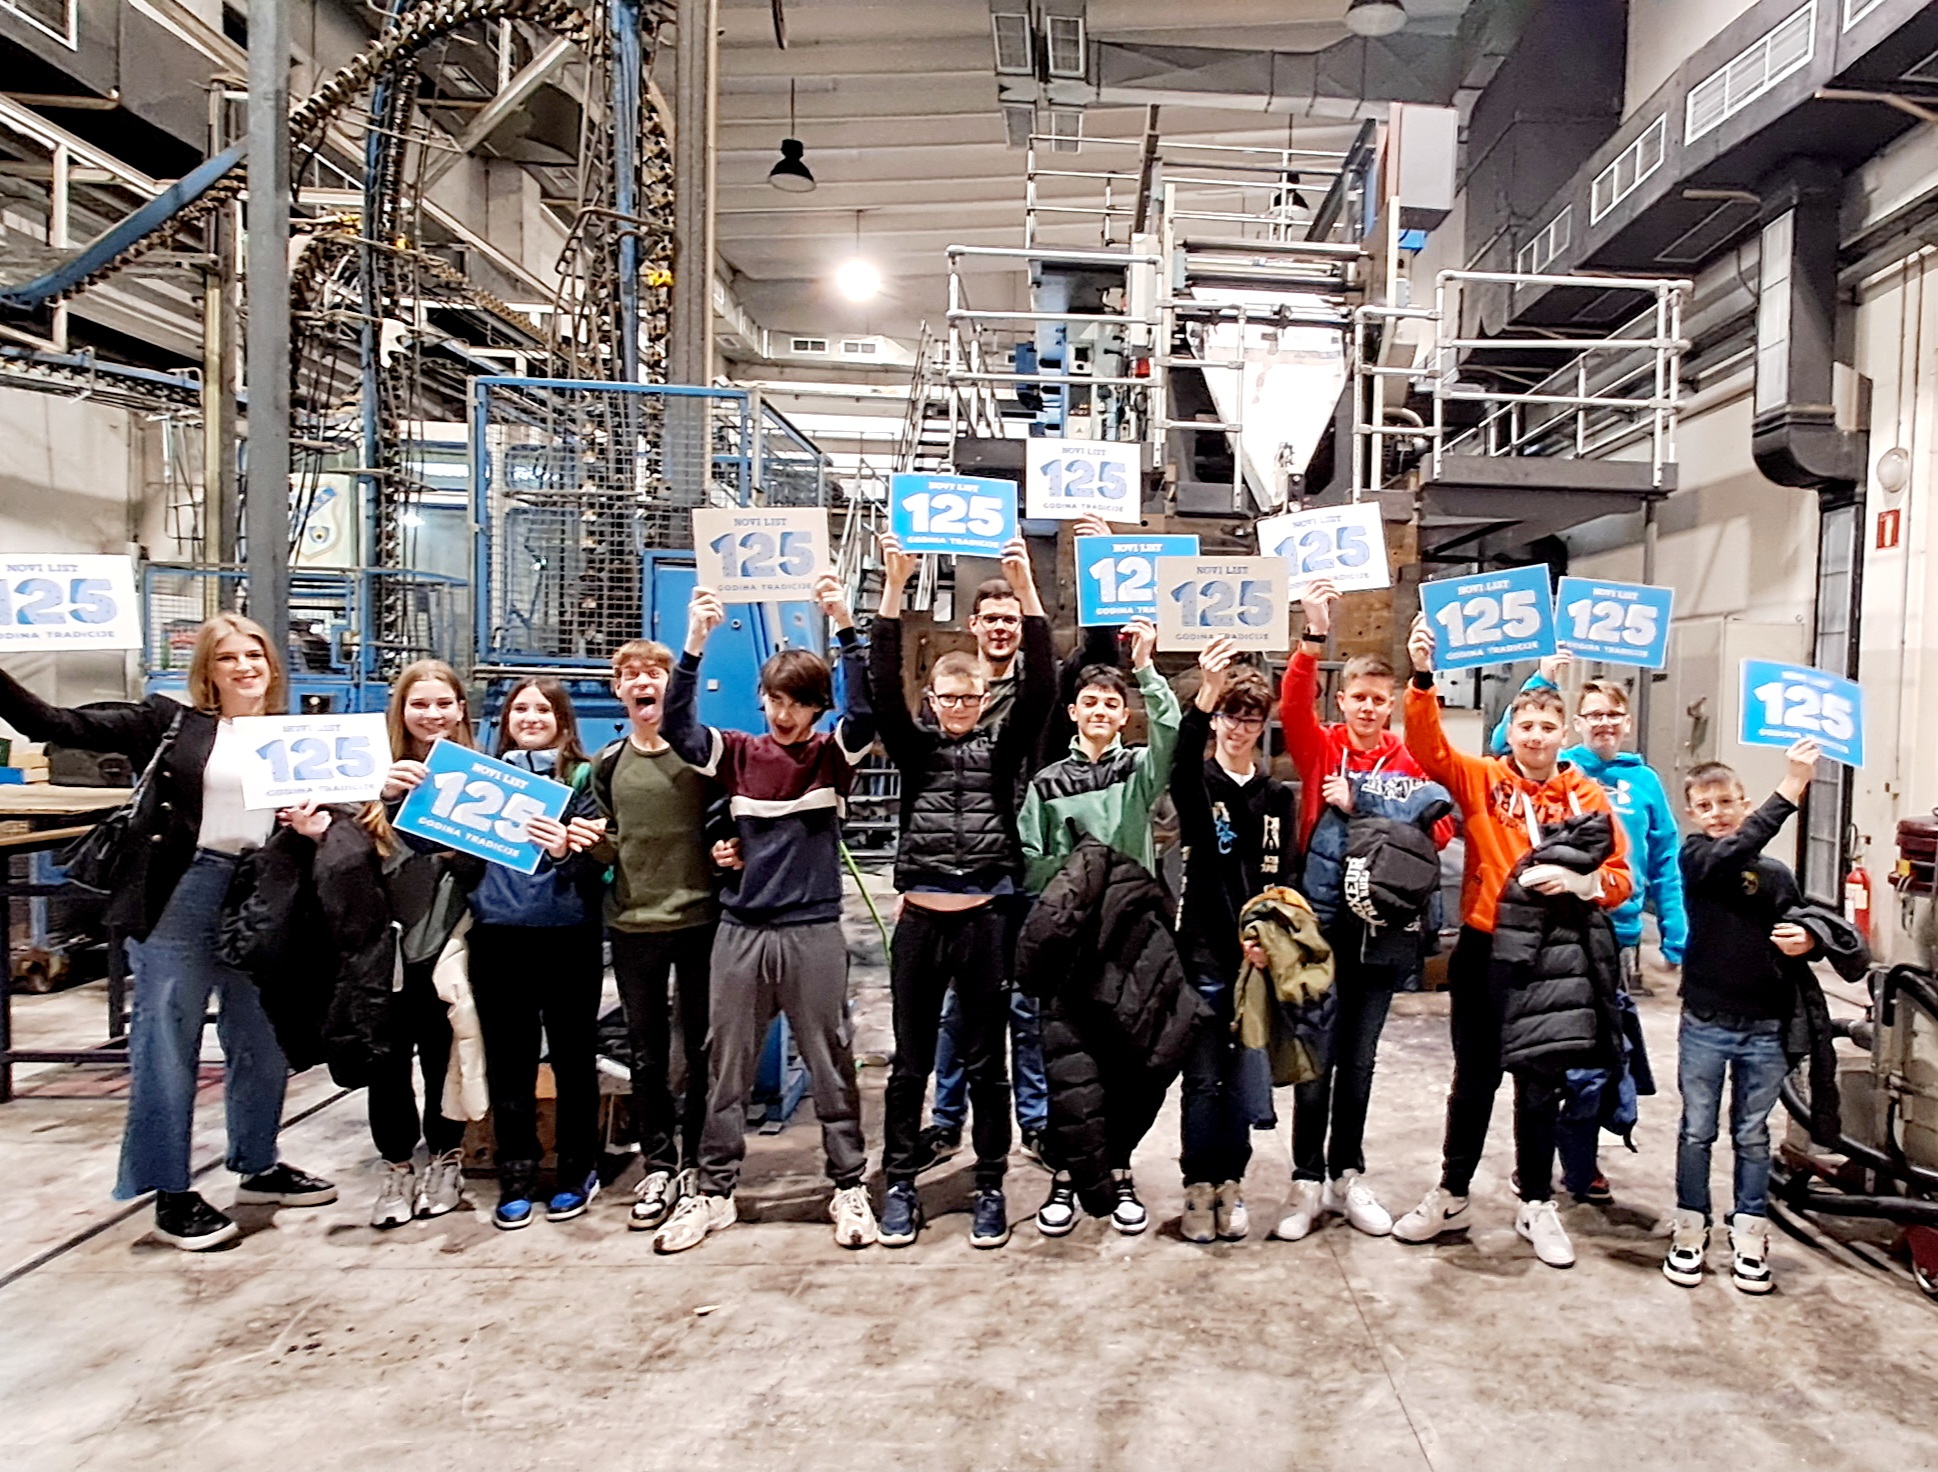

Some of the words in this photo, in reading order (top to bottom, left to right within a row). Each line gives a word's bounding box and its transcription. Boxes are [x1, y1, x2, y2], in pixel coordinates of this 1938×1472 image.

[1040, 459, 1127, 500] 125
[734, 518, 760, 526] NOVI
[764, 518, 787, 526] LIST
[902, 492, 1004, 537] 125
[6, 564, 42, 572] NOVI
[48, 564, 78, 572] LIST
[710, 532, 814, 578] 125
[1196, 566, 1222, 574] NOVI
[1226, 566, 1248, 574] LIST
[1274, 526, 1370, 576] 125
[1088, 556, 1157, 602] 12
[1170, 580, 1274, 626] 125
[1436, 590, 1540, 648] 125
[1568, 599, 1658, 646] 125
[1753, 682, 1854, 740] 125
[256, 736, 375, 782] 125
[472, 762, 502, 780] NOVI
[431, 771, 546, 843] 125
